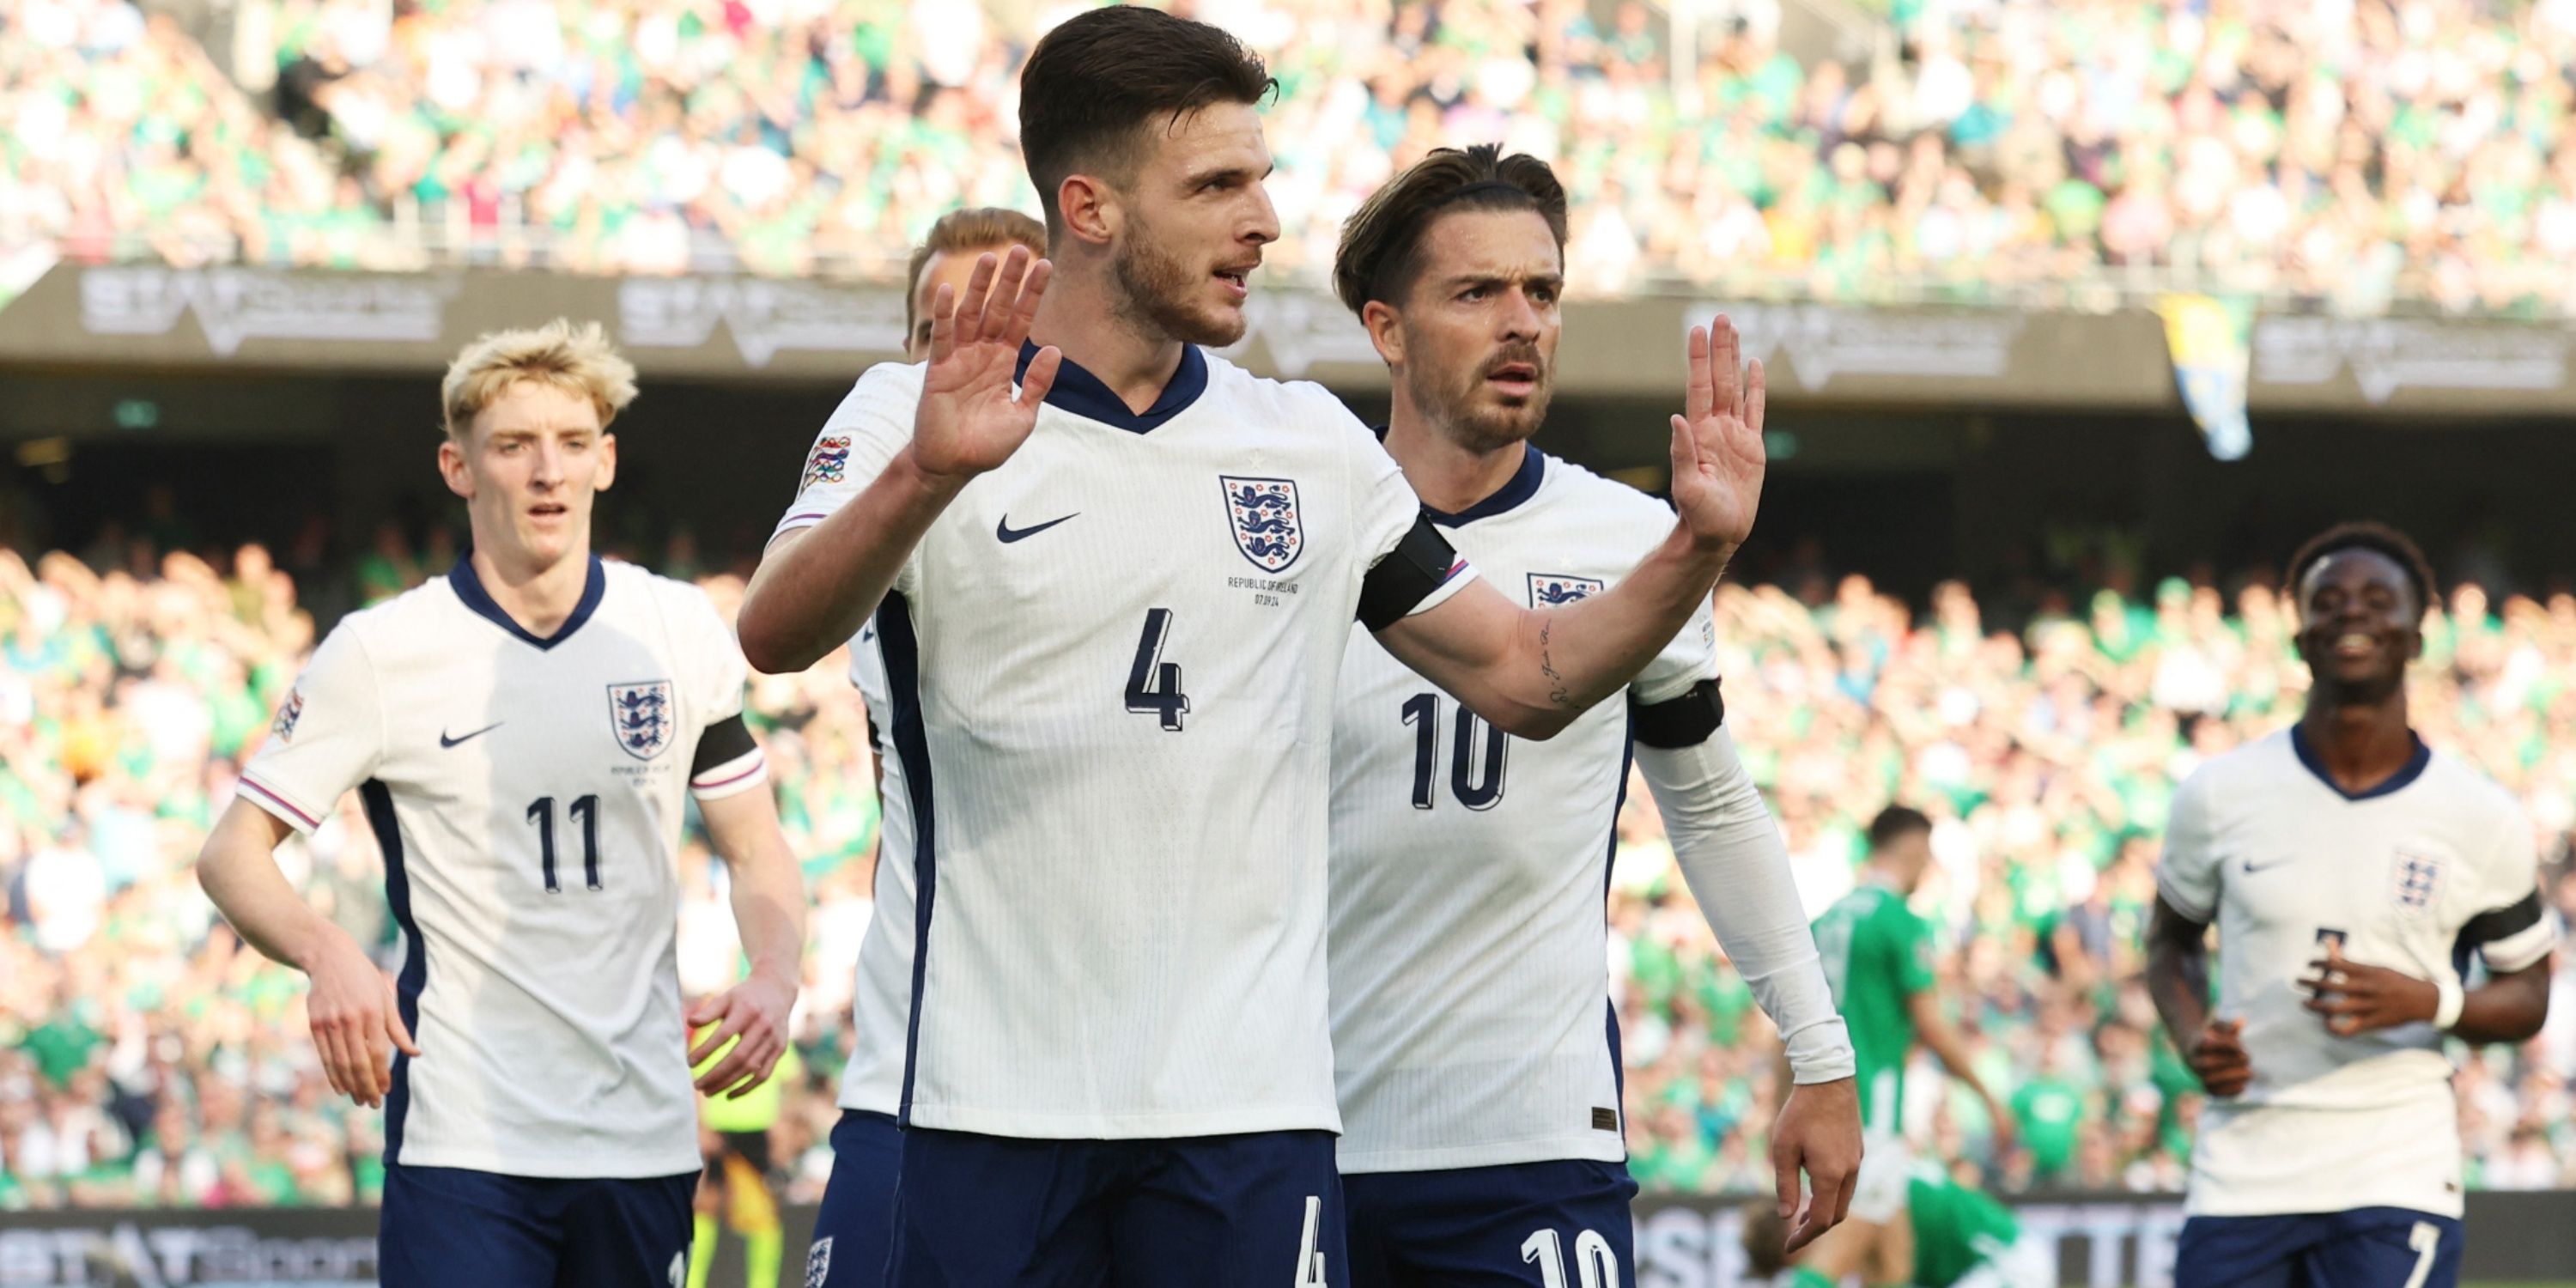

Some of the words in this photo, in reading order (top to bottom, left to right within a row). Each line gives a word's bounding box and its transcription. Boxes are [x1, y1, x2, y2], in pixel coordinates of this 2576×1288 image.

[1228, 576, 1267, 590] REPUBLIC
[1125, 608, 1190, 732] 4
[1402, 693, 1510, 811] 10
[526, 794, 603, 894] 11
[1294, 1195, 1328, 1288] 4
[1521, 1228, 1619, 1288] 10
[2403, 1220, 2441, 1288] 7
